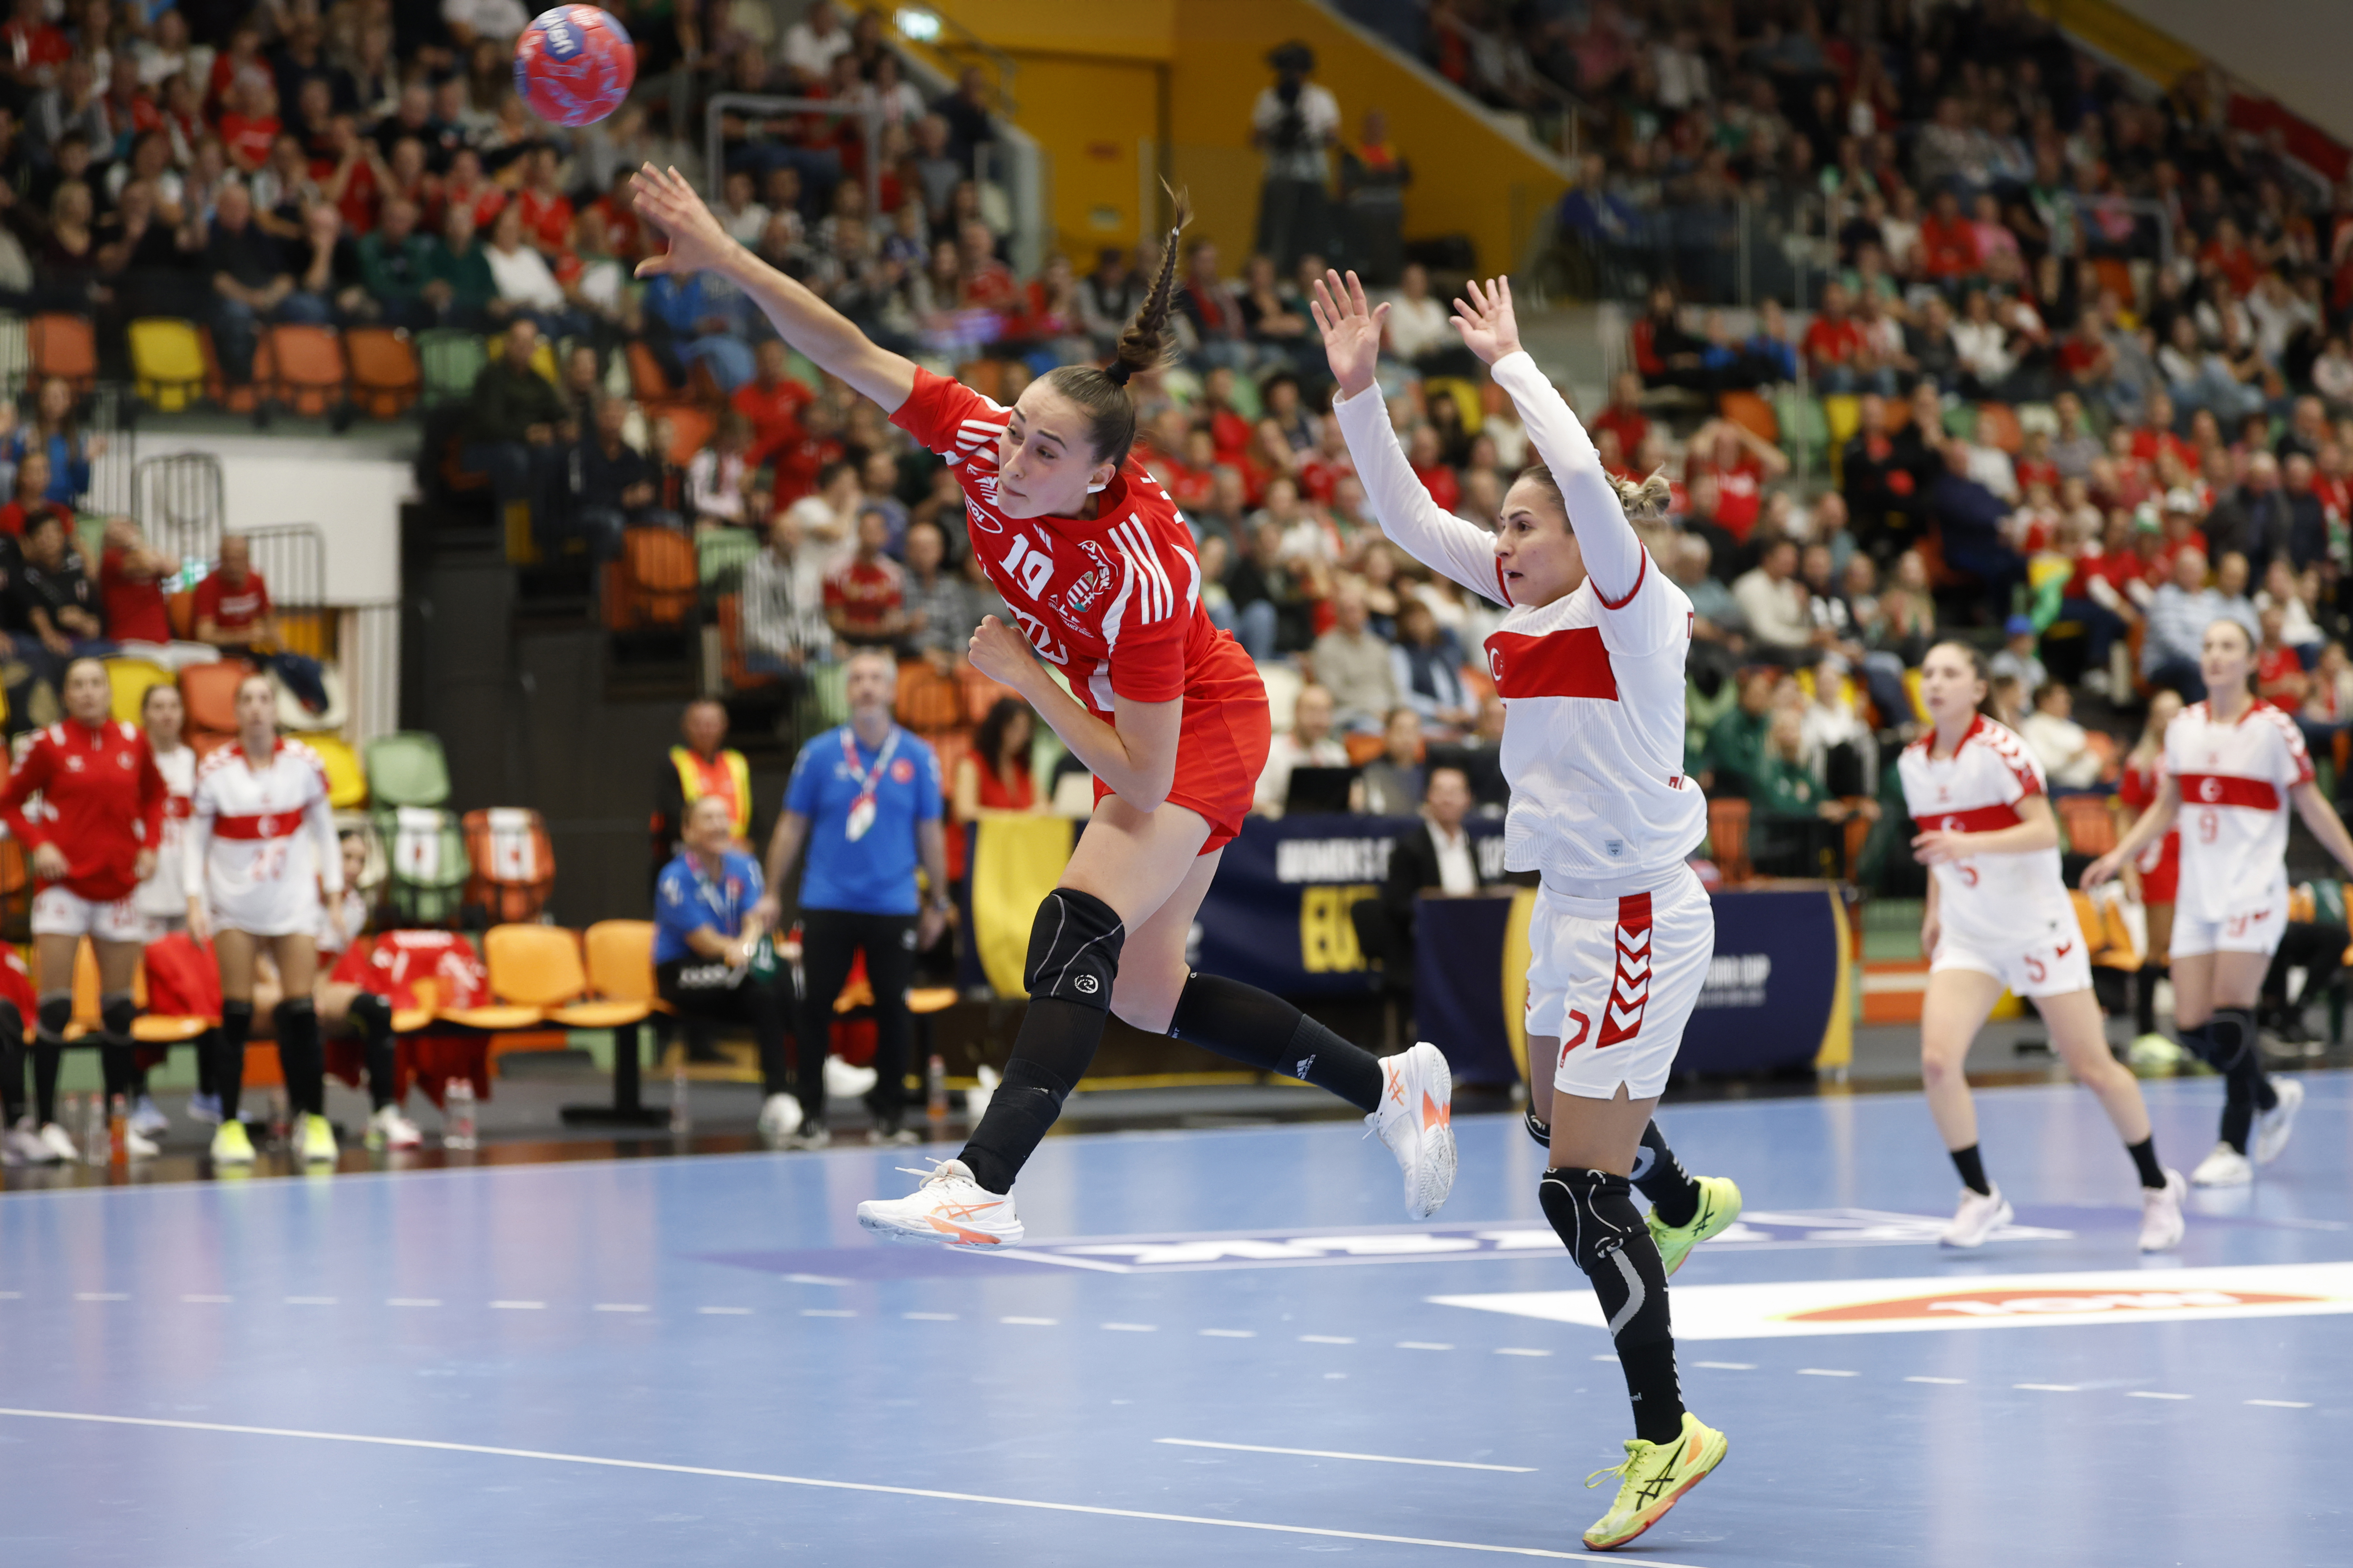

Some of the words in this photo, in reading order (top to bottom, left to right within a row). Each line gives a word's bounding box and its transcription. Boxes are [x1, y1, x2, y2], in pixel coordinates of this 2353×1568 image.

[998, 532, 1055, 601] 19
[1078, 628, 1095, 638] GROUP
[2199, 808, 2219, 845] 9
[2024, 953, 2047, 984] 5
